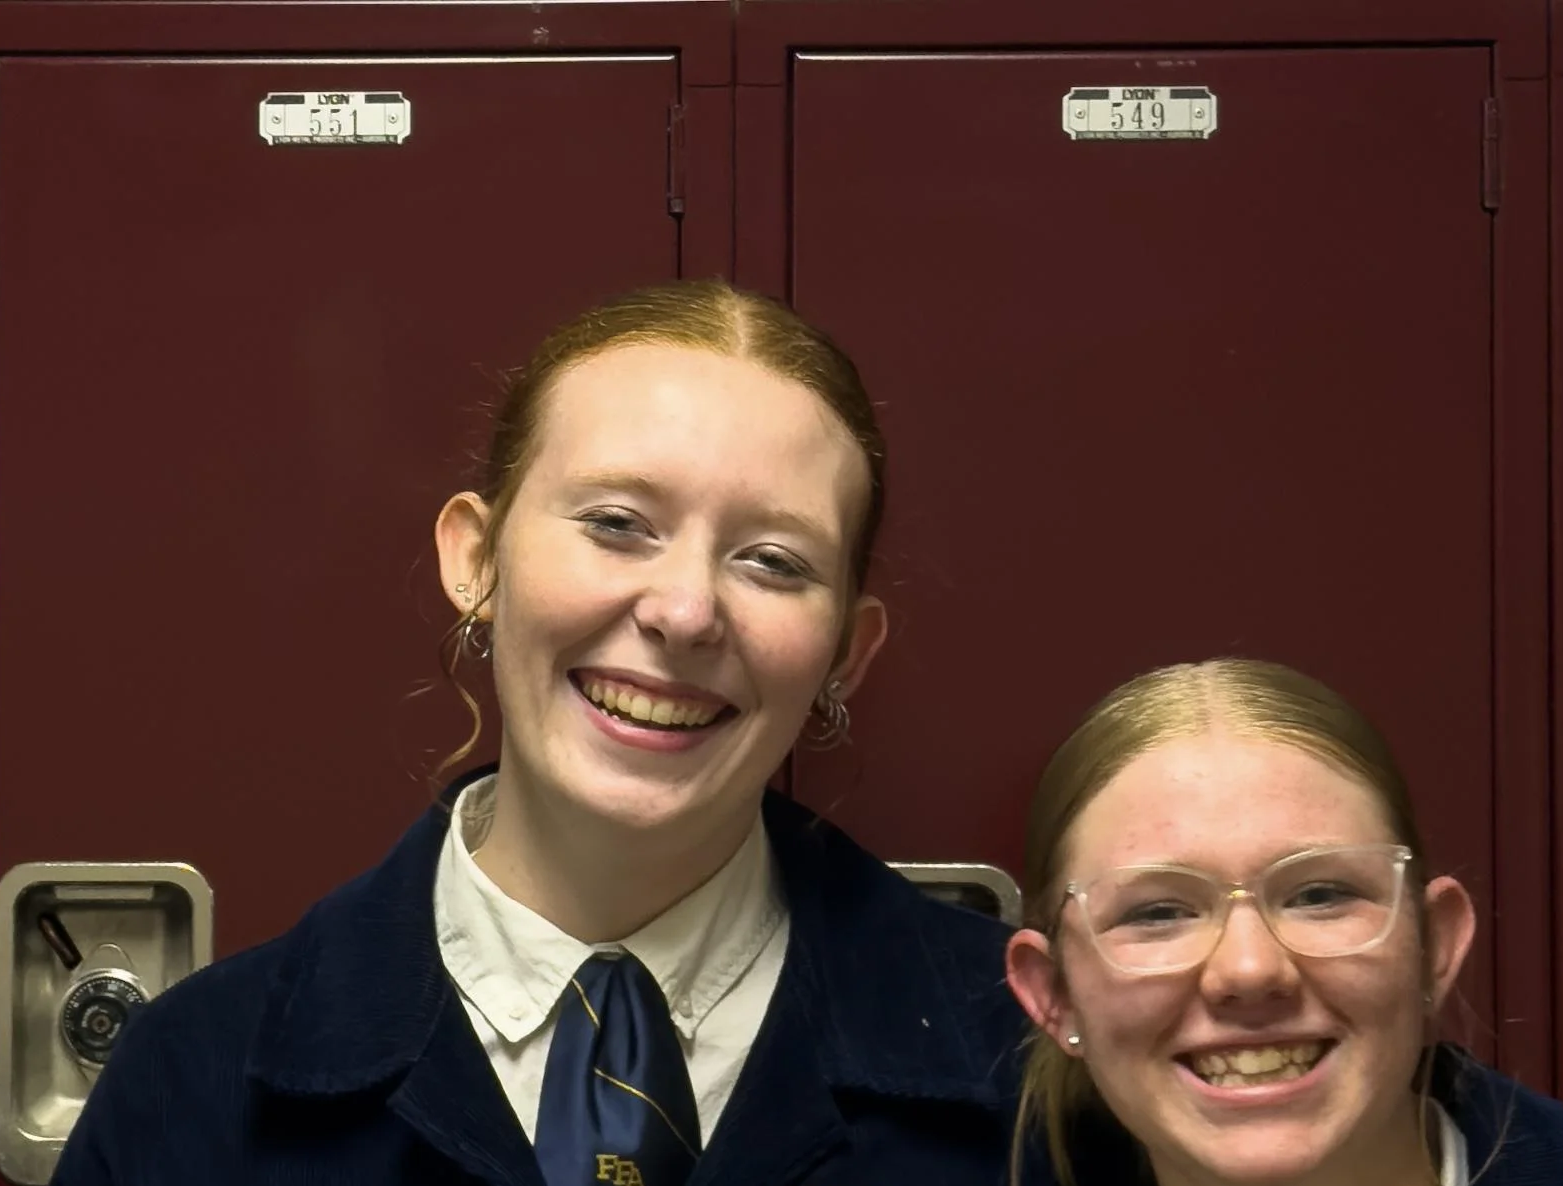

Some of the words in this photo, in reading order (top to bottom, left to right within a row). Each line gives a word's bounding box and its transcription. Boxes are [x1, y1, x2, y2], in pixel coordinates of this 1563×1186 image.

[318, 94, 350, 105] LYON
[1122, 89, 1155, 100] LYON
[309, 108, 358, 136] 551
[1110, 102, 1166, 129] 549
